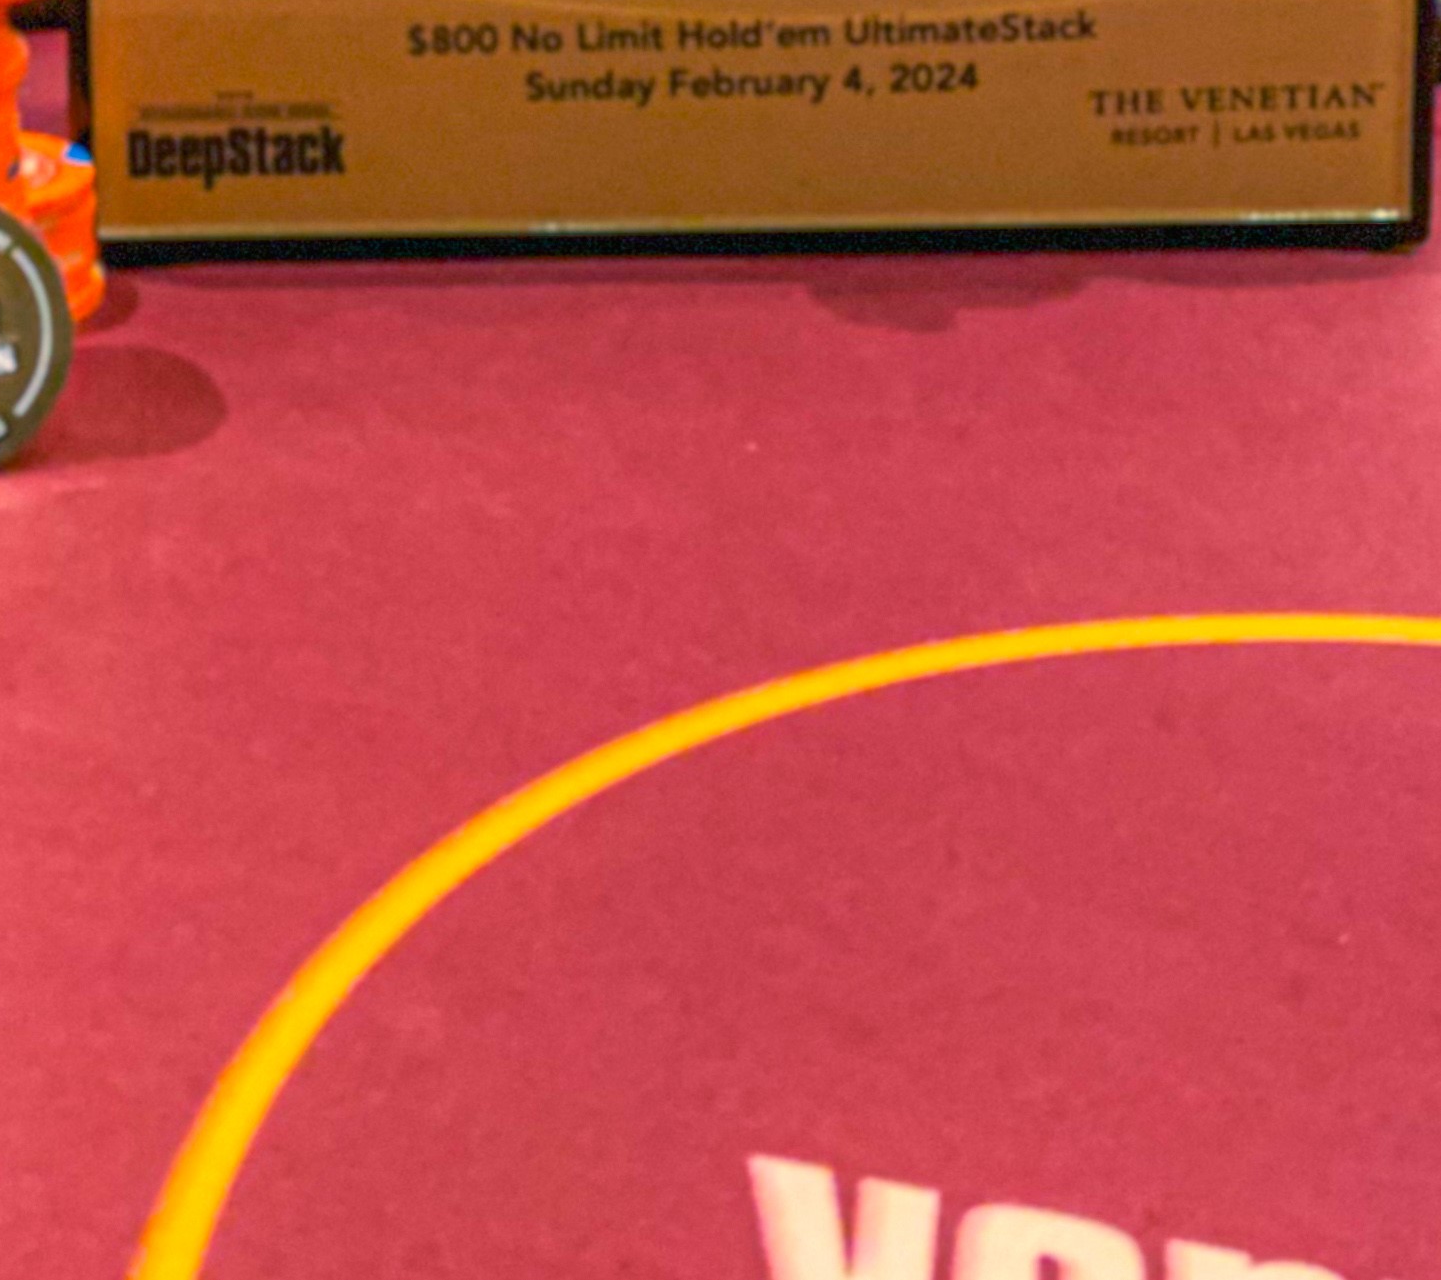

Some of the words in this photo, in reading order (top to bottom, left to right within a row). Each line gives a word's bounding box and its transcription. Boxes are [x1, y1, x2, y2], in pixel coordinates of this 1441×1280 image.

[407, 22, 499, 57] $800
[511, 22, 564, 53] No
[576, 19, 663, 53] Limit
[677, 17, 832, 51] Hold'em
[843, 10, 1097, 46] UltimateStack
[525, 68, 656, 109] Sunday
[669, 63, 831, 105] February
[843, 63, 875, 98] 4,
[889, 61, 980, 95] 2024
[1088, 87, 1164, 117] THE
[1233, 122, 1276, 143] LAS
[1283, 119, 1361, 141] VEGAS
[126, 124, 346, 192] DeepStack
